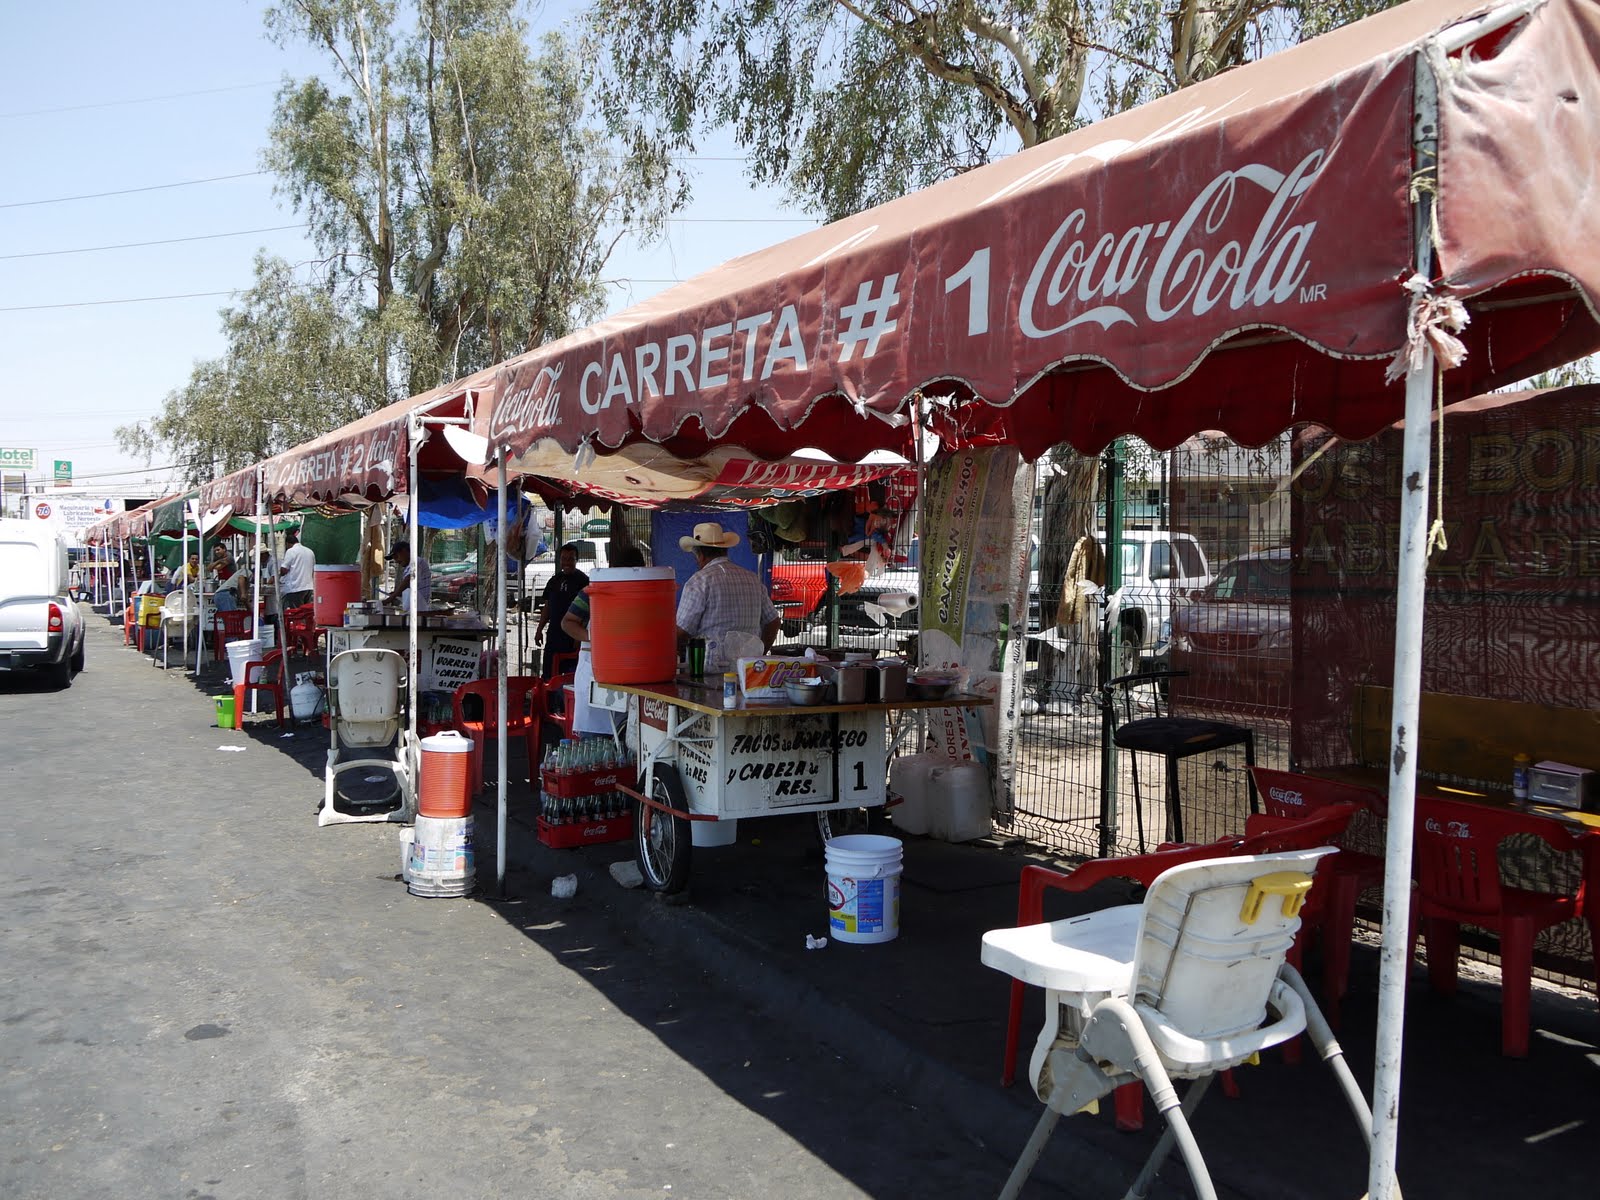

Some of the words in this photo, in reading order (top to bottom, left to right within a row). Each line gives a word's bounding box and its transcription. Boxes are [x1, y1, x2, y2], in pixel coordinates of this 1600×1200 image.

[579, 304, 809, 415] CARRETA
[837, 273, 901, 363] #
[945, 247, 991, 337] 1
[1018, 148, 1326, 339] Coca-Cola
[1300, 284, 1327, 304] MR
[490, 361, 565, 440] Coca-Cola
[0, 449, 34, 460] otel
[278, 450, 337, 487] CARRETA
[340, 449, 352, 477] #
[351, 444, 364, 474] 2
[38, 506, 51, 516] 76
[438, 643, 469, 656] TACOS
[436, 656, 476, 670] BORREGO
[439, 669, 473, 680] CABEZA
[731, 734, 780, 755] TACOS
[792, 730, 868, 751] BORREGO
[943, 720, 957, 761] JORES
[692, 767, 707, 784] RES
[727, 768, 738, 784] y
[738, 760, 803, 782] CABEZA
[853, 761, 868, 791] 1
[1269, 787, 1304, 805] Coca-Cola
